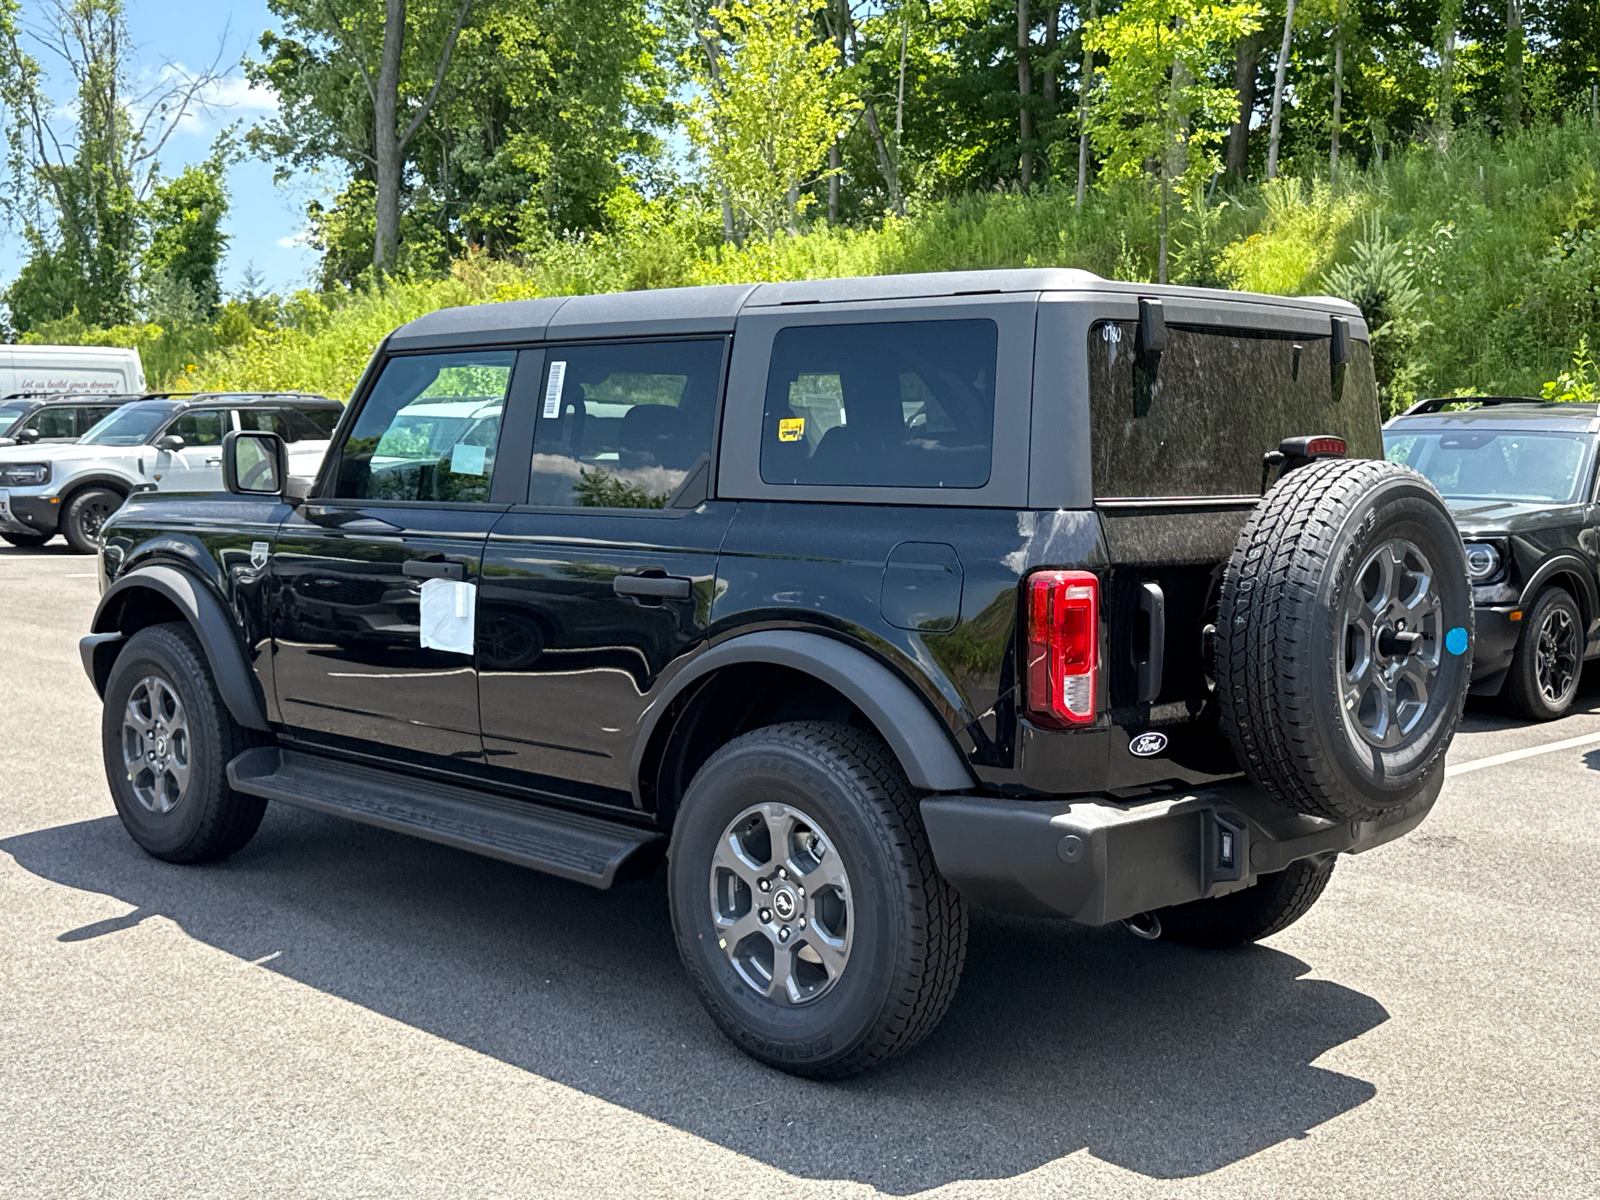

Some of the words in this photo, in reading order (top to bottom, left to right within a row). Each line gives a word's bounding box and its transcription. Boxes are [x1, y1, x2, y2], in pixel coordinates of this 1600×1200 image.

[22, 380, 34, 389] Let
[47, 380, 69, 389] build
[69, 382, 88, 392] your
[90, 380, 120, 389] dream!
[1137, 735, 1162, 753] Ford
